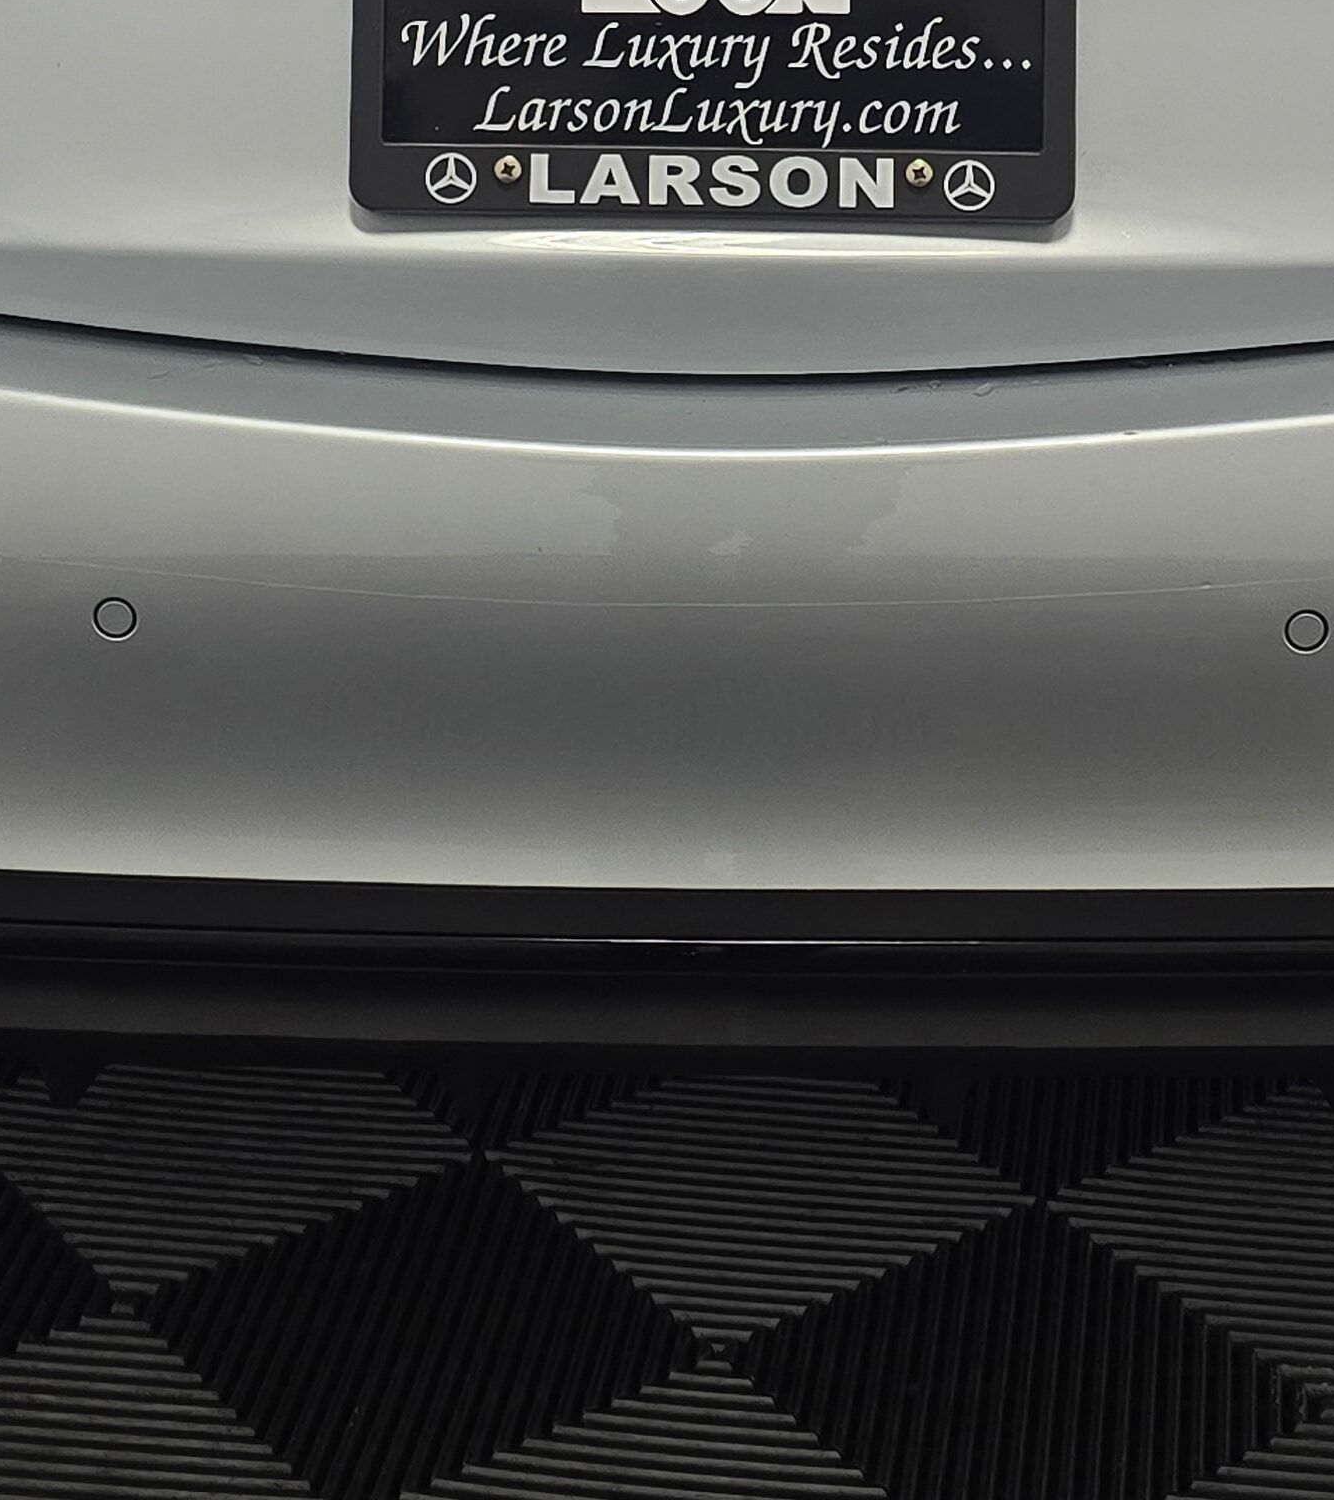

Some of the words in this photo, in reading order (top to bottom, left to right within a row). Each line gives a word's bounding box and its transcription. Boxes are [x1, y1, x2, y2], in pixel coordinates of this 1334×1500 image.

[400, 13, 567, 68] Where
[582, 20, 771, 89] Luxury
[787, 16, 1032, 79] Resides...
[472, 85, 961, 149] LarsonLuxury.com
[529, 153, 895, 209] LARSON
